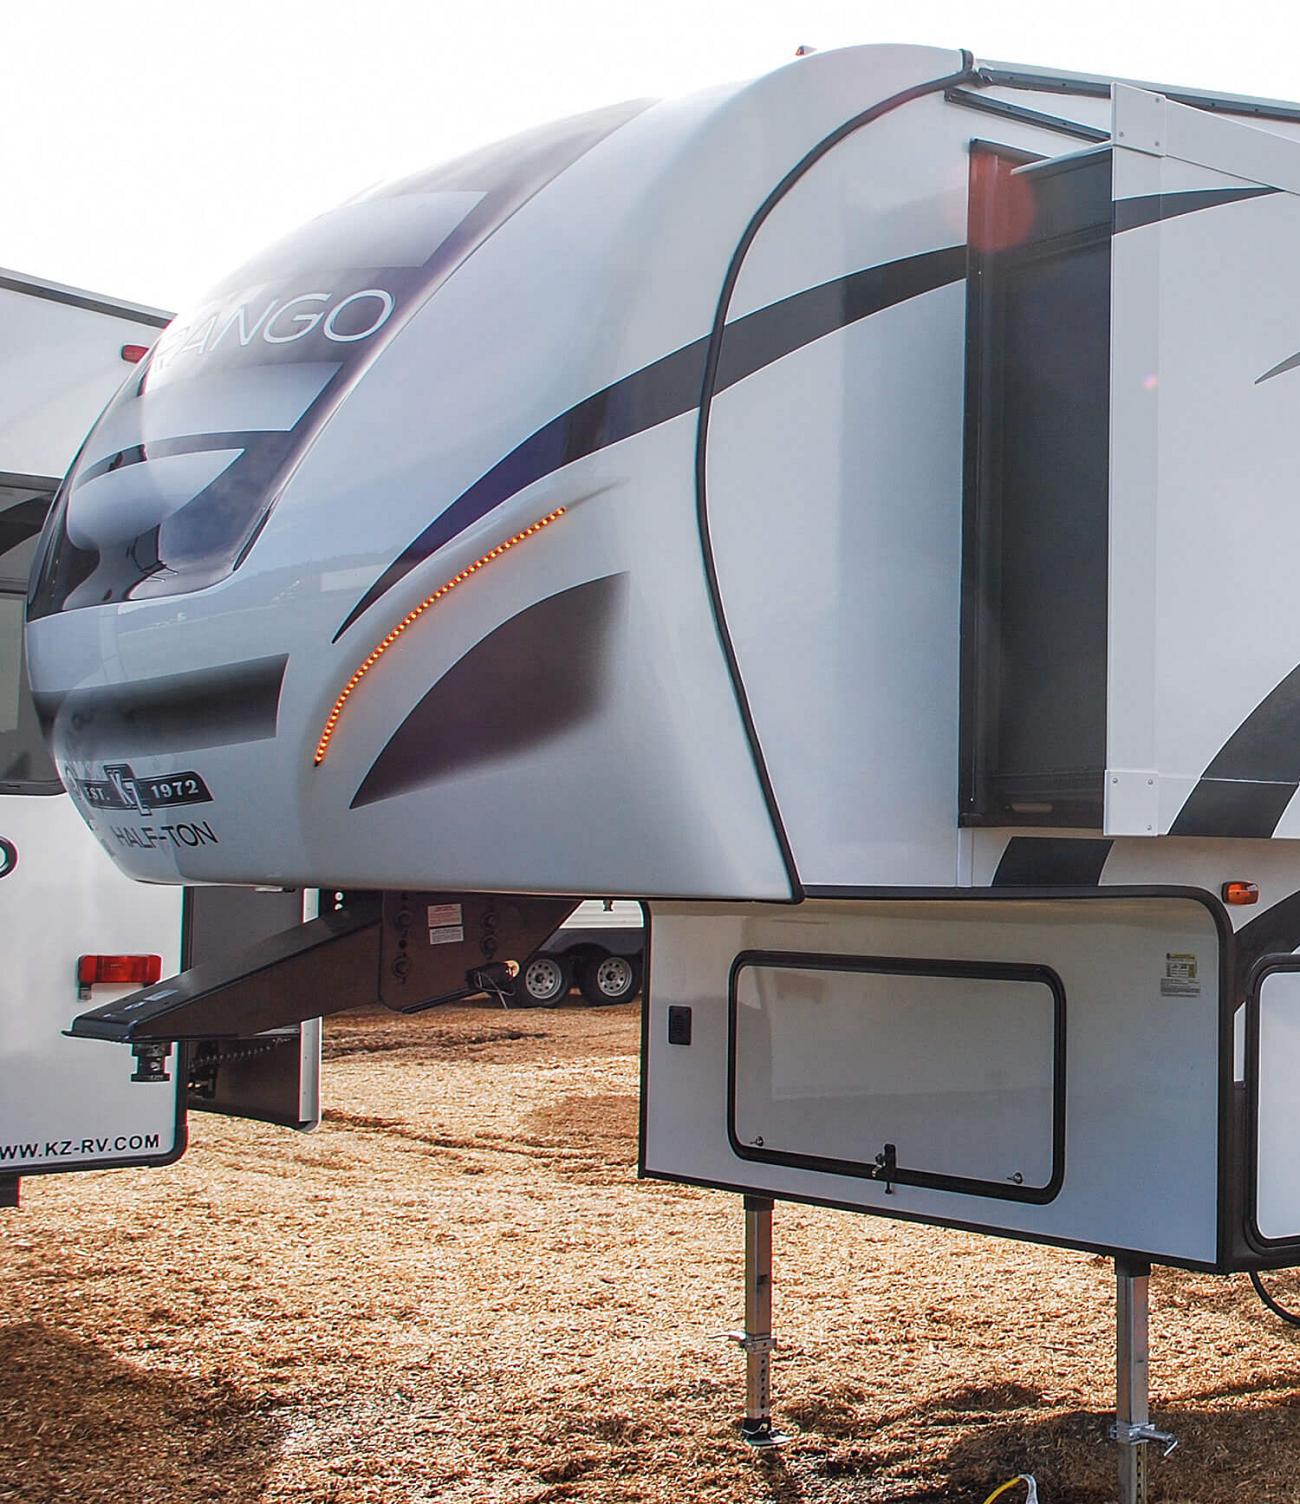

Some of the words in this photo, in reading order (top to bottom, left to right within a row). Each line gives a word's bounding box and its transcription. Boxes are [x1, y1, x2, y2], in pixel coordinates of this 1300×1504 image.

[84, 786, 110, 801] EST.
[151, 779, 199, 799] 1972
[110, 821, 219, 849] HALF-TON
